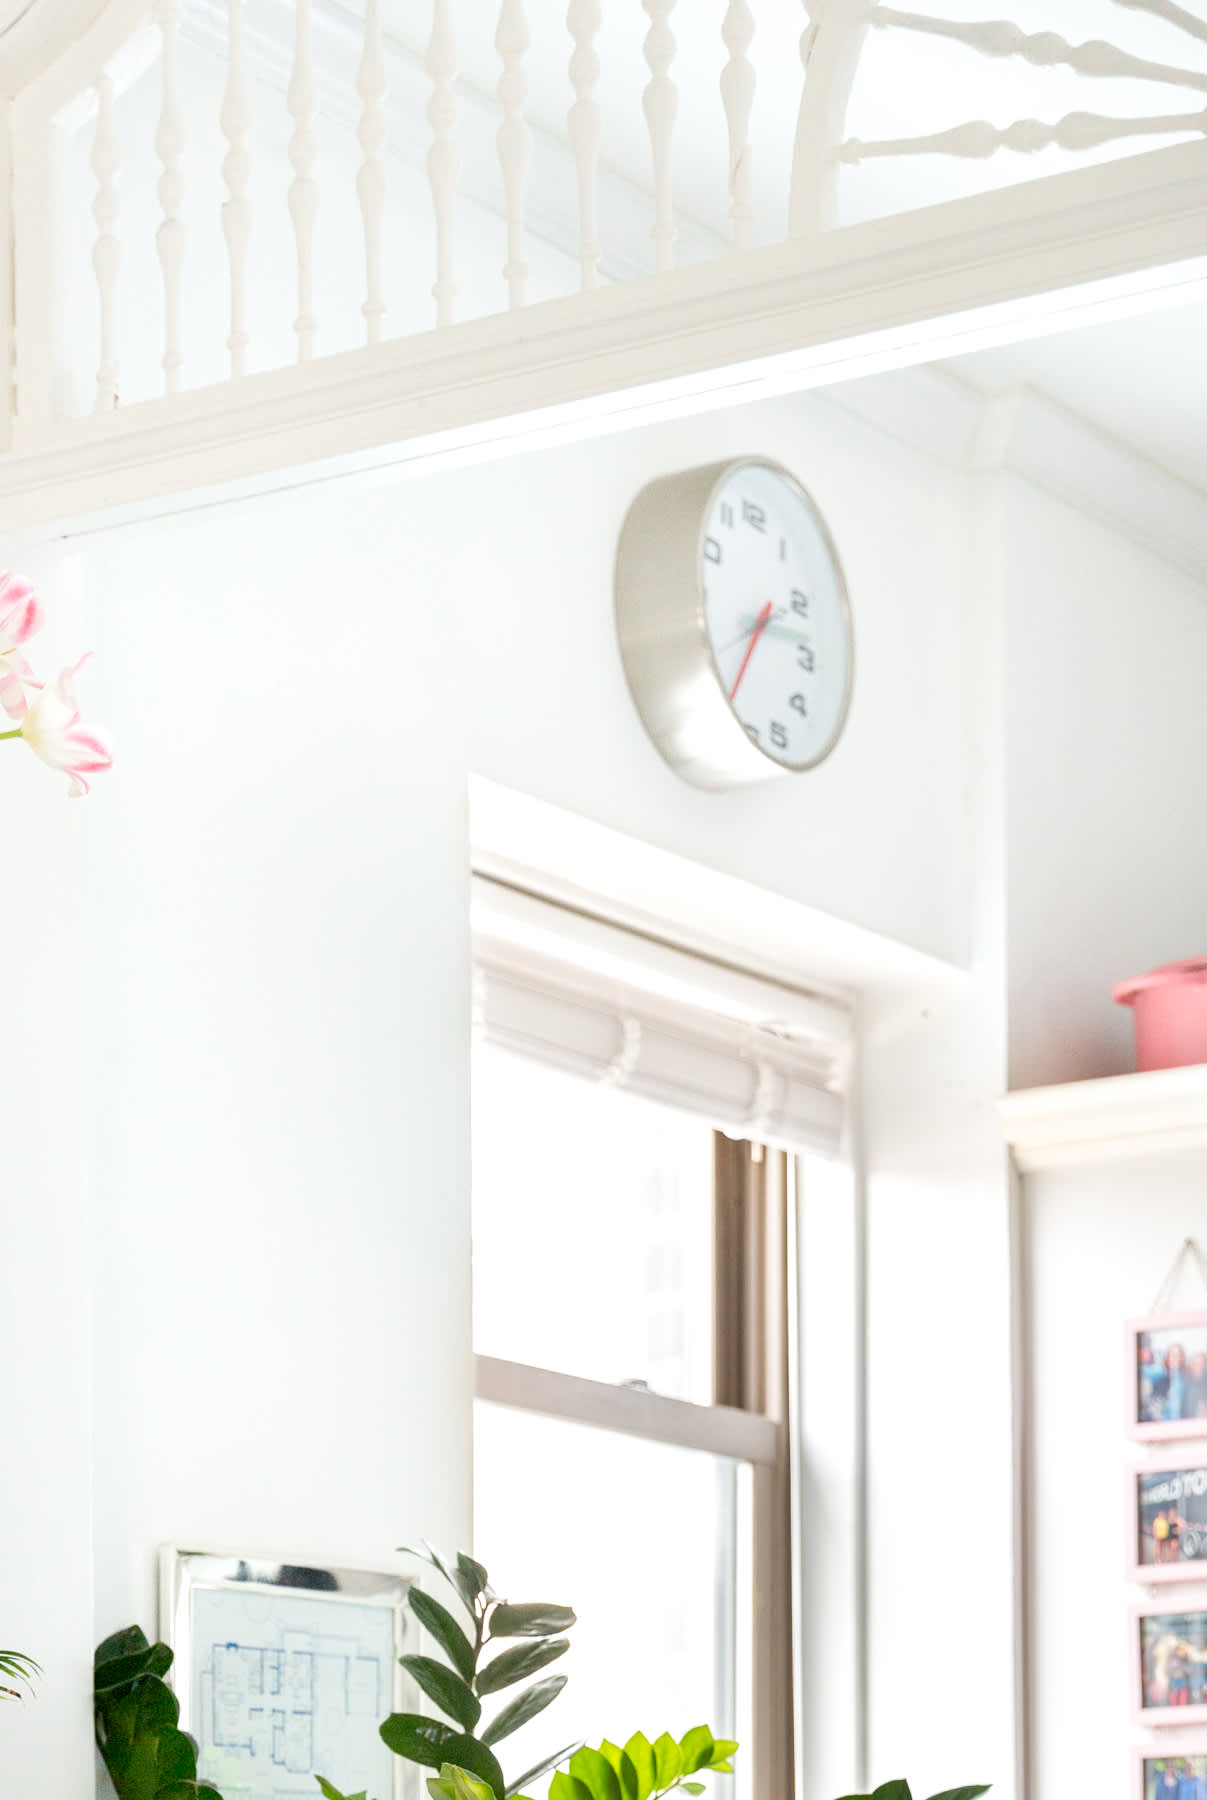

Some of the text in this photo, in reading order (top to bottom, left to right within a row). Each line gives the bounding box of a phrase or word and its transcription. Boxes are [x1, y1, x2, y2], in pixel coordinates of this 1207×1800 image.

[790, 587, 808, 618] 2
[796, 644, 814, 674] 3
[769, 720, 788, 749] 5
